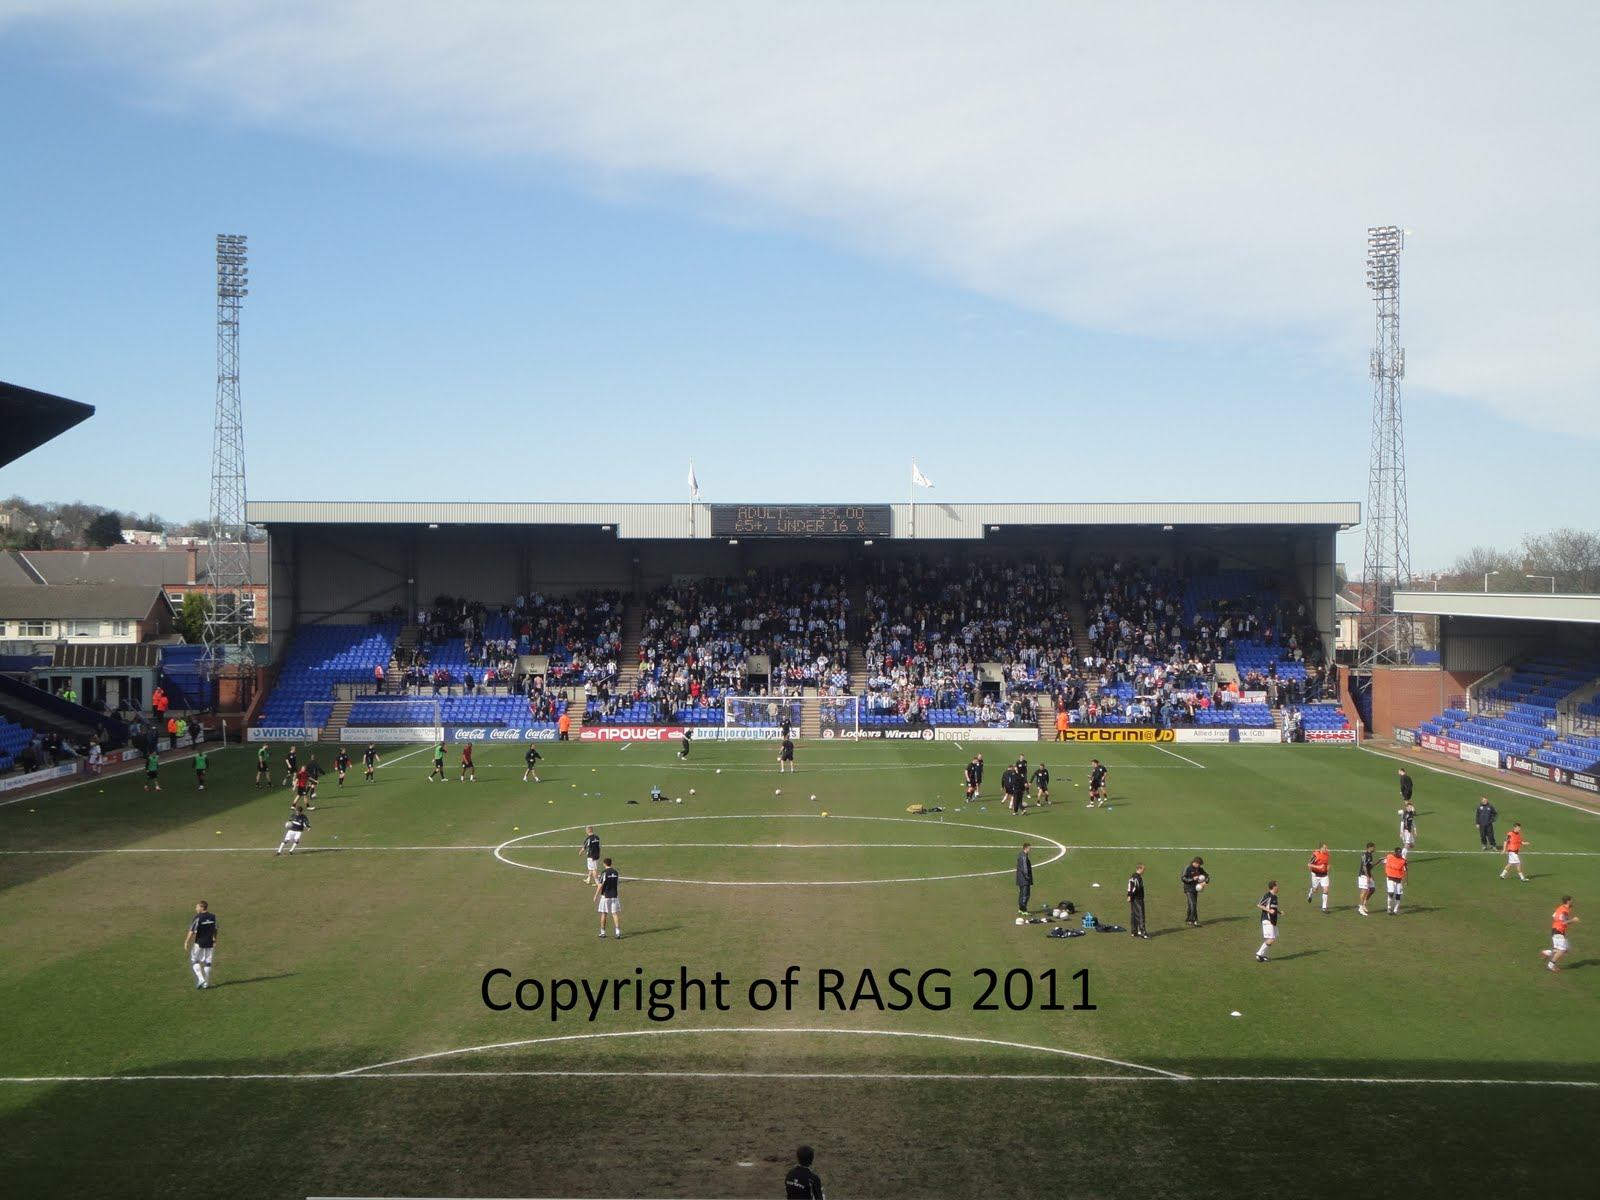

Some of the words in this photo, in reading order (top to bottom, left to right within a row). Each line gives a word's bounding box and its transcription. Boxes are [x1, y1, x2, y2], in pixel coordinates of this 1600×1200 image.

[777, 520, 825, 532] UNDER
[833, 520, 849, 532] 16
[262, 728, 313, 737] WIRRAL
[597, 728, 667, 740] npower
[884, 729, 922, 739] Wirral
[938, 729, 970, 741] home
